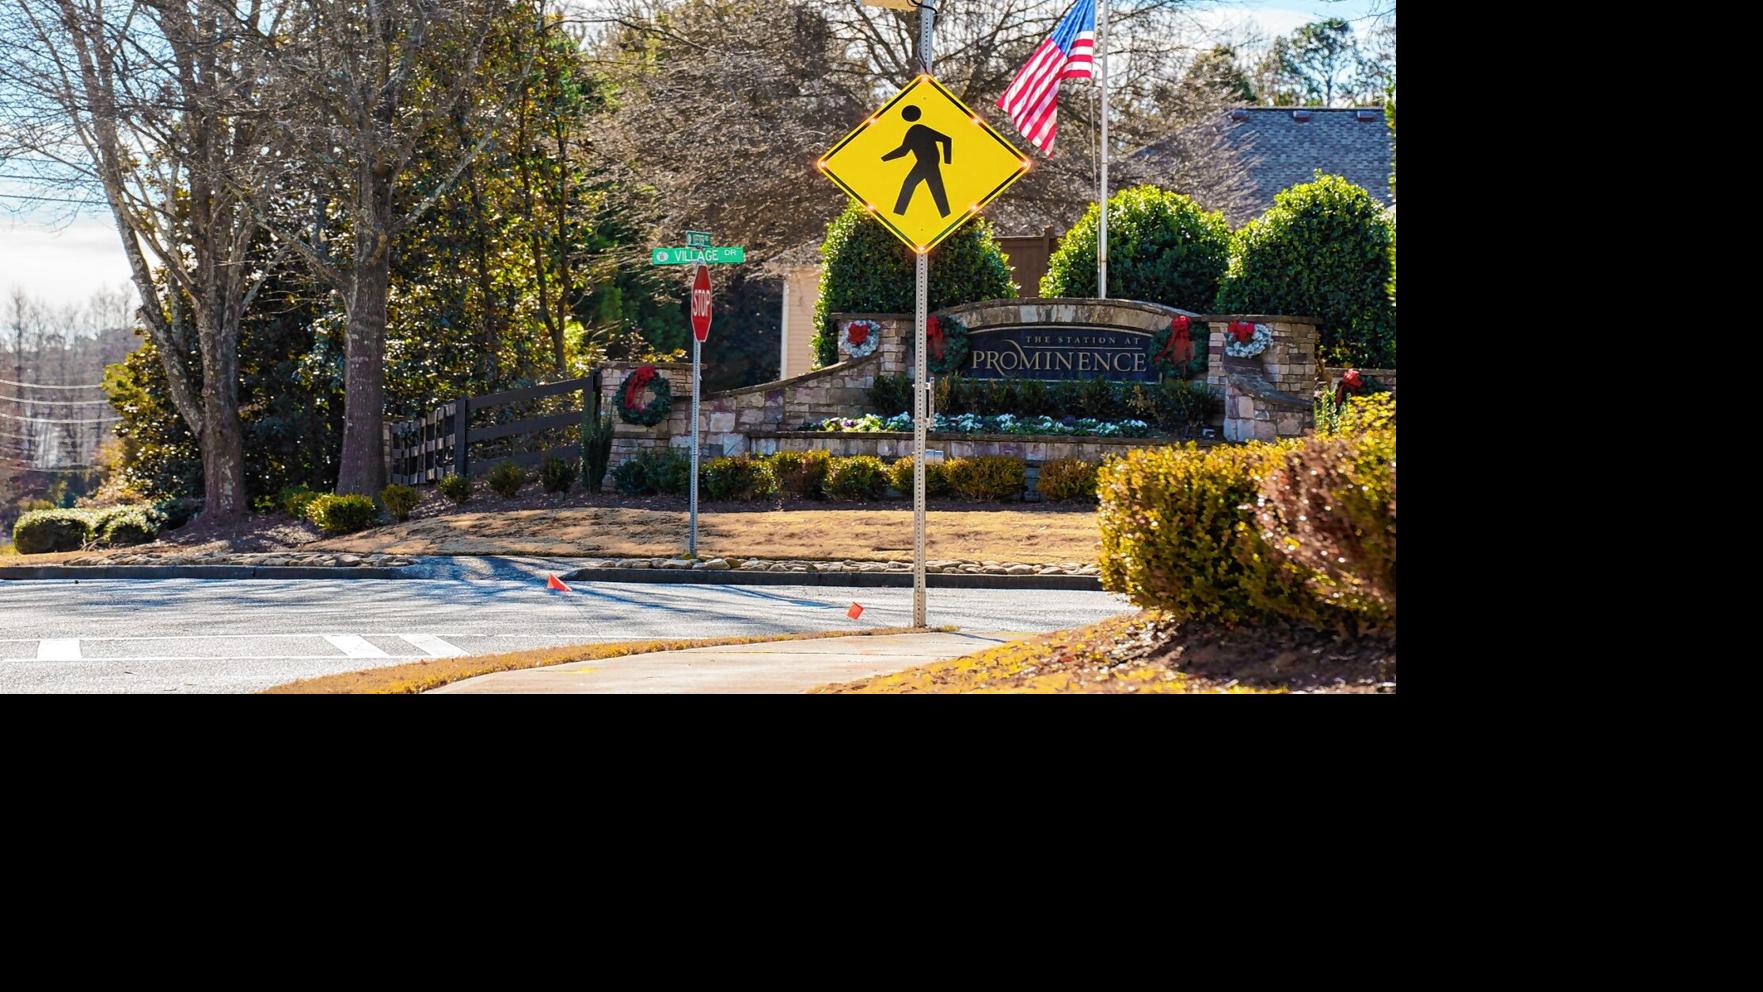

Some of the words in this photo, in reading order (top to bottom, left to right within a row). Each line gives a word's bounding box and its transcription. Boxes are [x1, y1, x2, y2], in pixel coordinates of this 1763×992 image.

[674, 250, 719, 262] VILLAGE
[693, 289, 711, 317] STOP
[1025, 335, 1051, 344] THE
[1058, 336, 1117, 345] STATION
[1125, 337, 1141, 345] AT
[971, 346, 1147, 376] PROMINENCE
